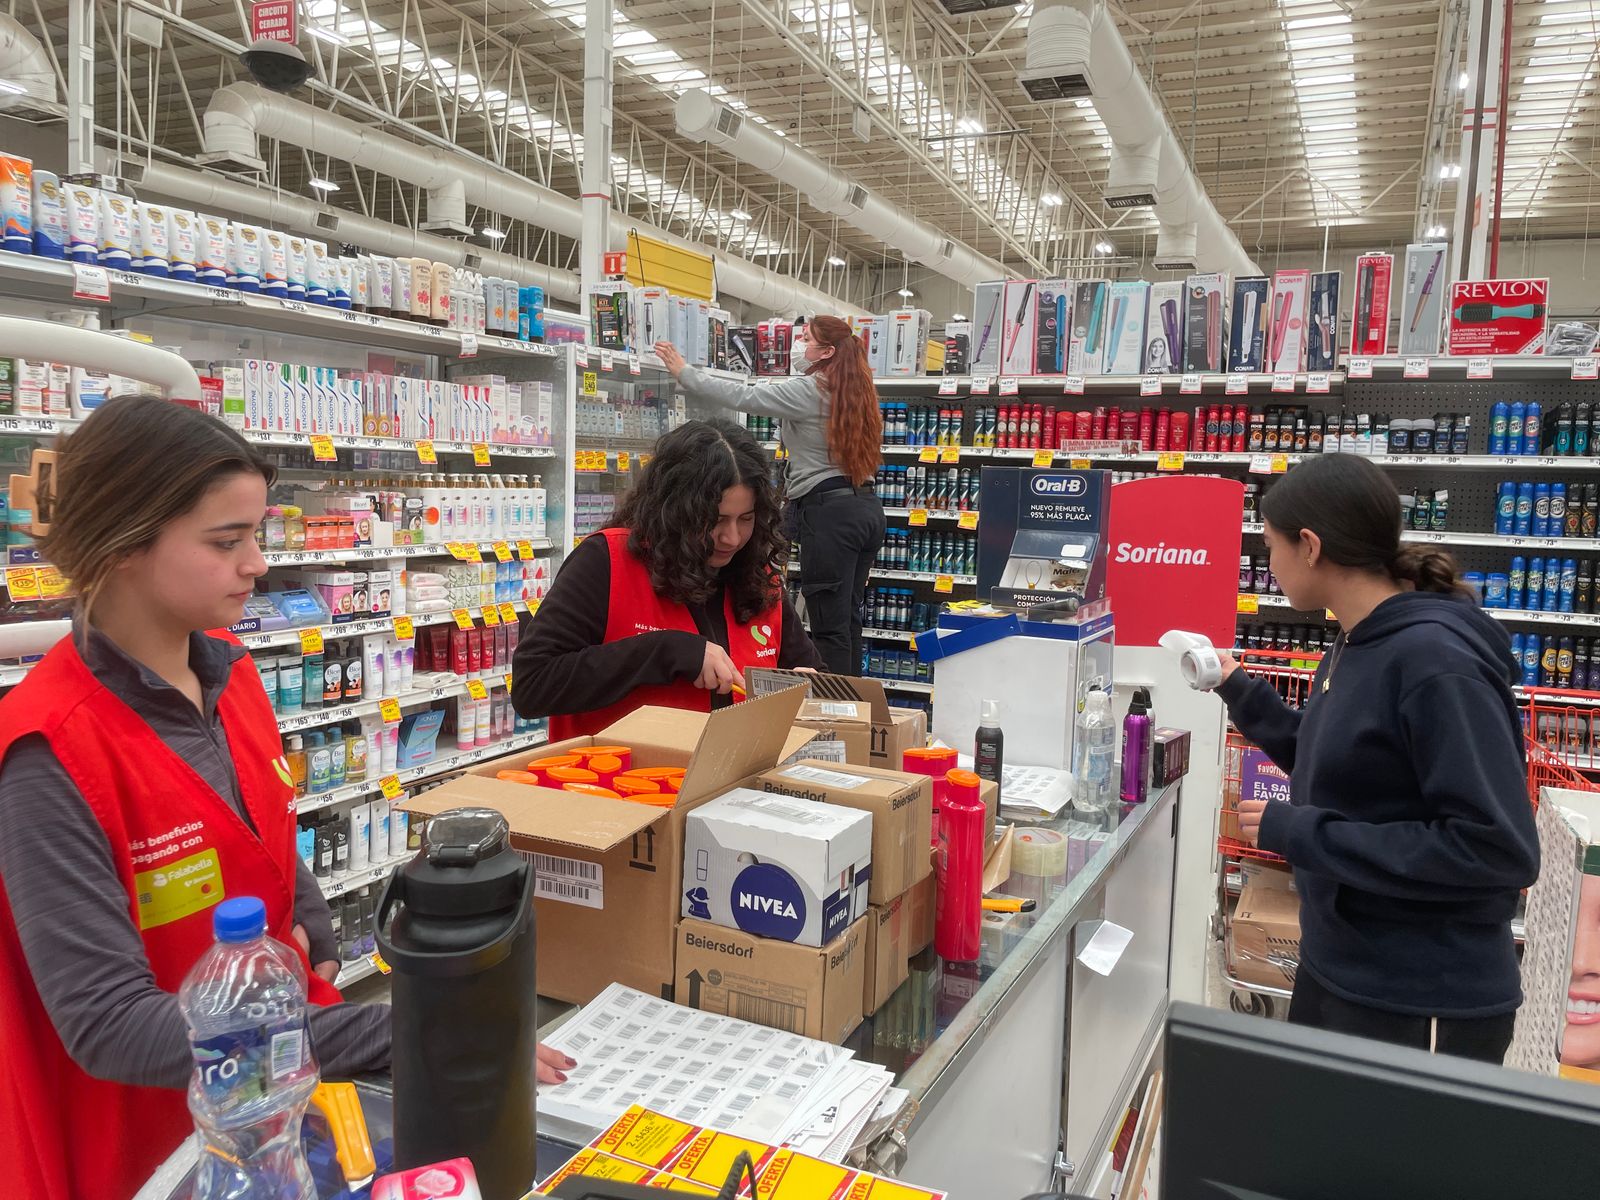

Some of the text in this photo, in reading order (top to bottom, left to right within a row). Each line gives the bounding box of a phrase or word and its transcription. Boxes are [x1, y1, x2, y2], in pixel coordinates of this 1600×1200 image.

[258, 5, 288, 18] CIRCUITO
[258, 17, 287, 30] CERRADO
[256, 32, 267, 41] LAS
[268, 31, 276, 40] 24
[1359, 257, 1391, 265] REVLON
[1455, 281, 1545, 298] REVLON
[33, 420, 53, 430] $143
[1034, 478, 1081, 492] Oral-B
[1046, 511, 1063, 520] MÁS
[1055, 505, 1085, 513] REMUEVE
[1115, 542, 1208, 565] Soriana
[1013, 593, 1056, 602] PROTECCIÓN
[232, 621, 257, 631] DIARIO
[634, 623, 648, 631] Más
[295, 717, 308, 726] $165
[764, 782, 827, 802] Beiersdorf
[1254, 782, 1268, 790] EL
[892, 787, 922, 811] Beiersdorf
[147, 820, 204, 847] beneficios
[181, 835, 203, 849] con
[167, 858, 213, 881] Falabella
[738, 891, 798, 920] NIVEA
[829, 906, 848, 929] NIVEA
[685, 932, 754, 959] Beiersdorf
[604, 1112, 638, 1146] OFERTA
[678, 1136, 711, 1170] OFERTA
[757, 1157, 788, 1194] OFERTA
